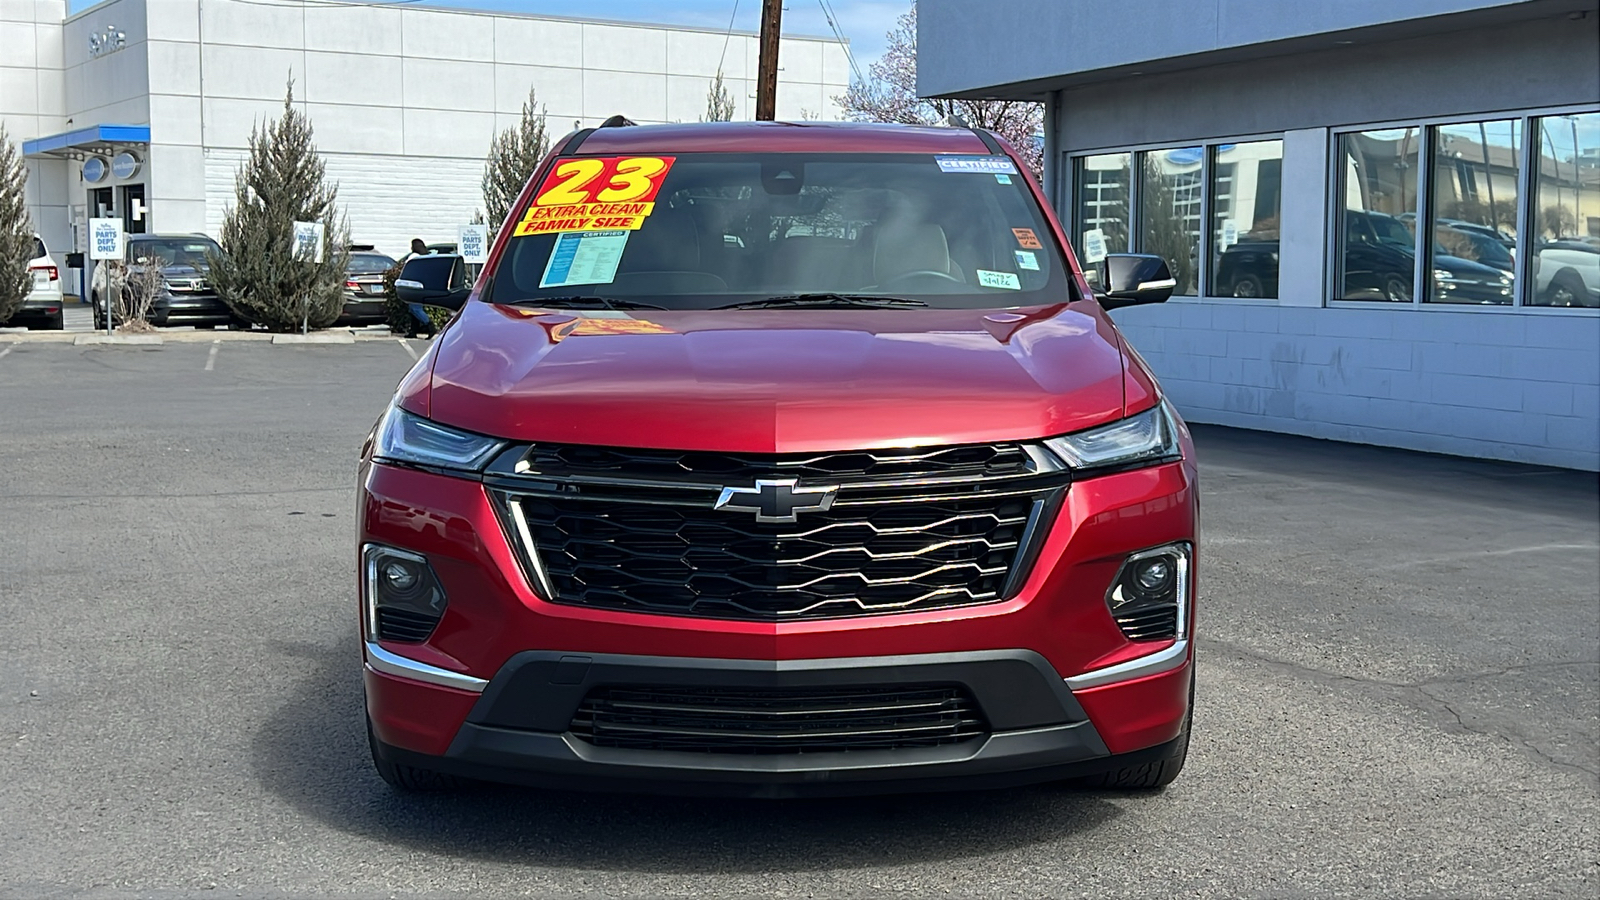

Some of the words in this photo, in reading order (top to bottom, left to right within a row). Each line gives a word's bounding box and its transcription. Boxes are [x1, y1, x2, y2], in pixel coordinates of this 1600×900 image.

[941, 160, 1010, 169] CERTIFIED
[537, 157, 667, 205] 23
[532, 205, 587, 220] EXTRA
[589, 203, 645, 216] CLEAN
[523, 218, 593, 232] FAMILY
[592, 217, 635, 229] SIZE
